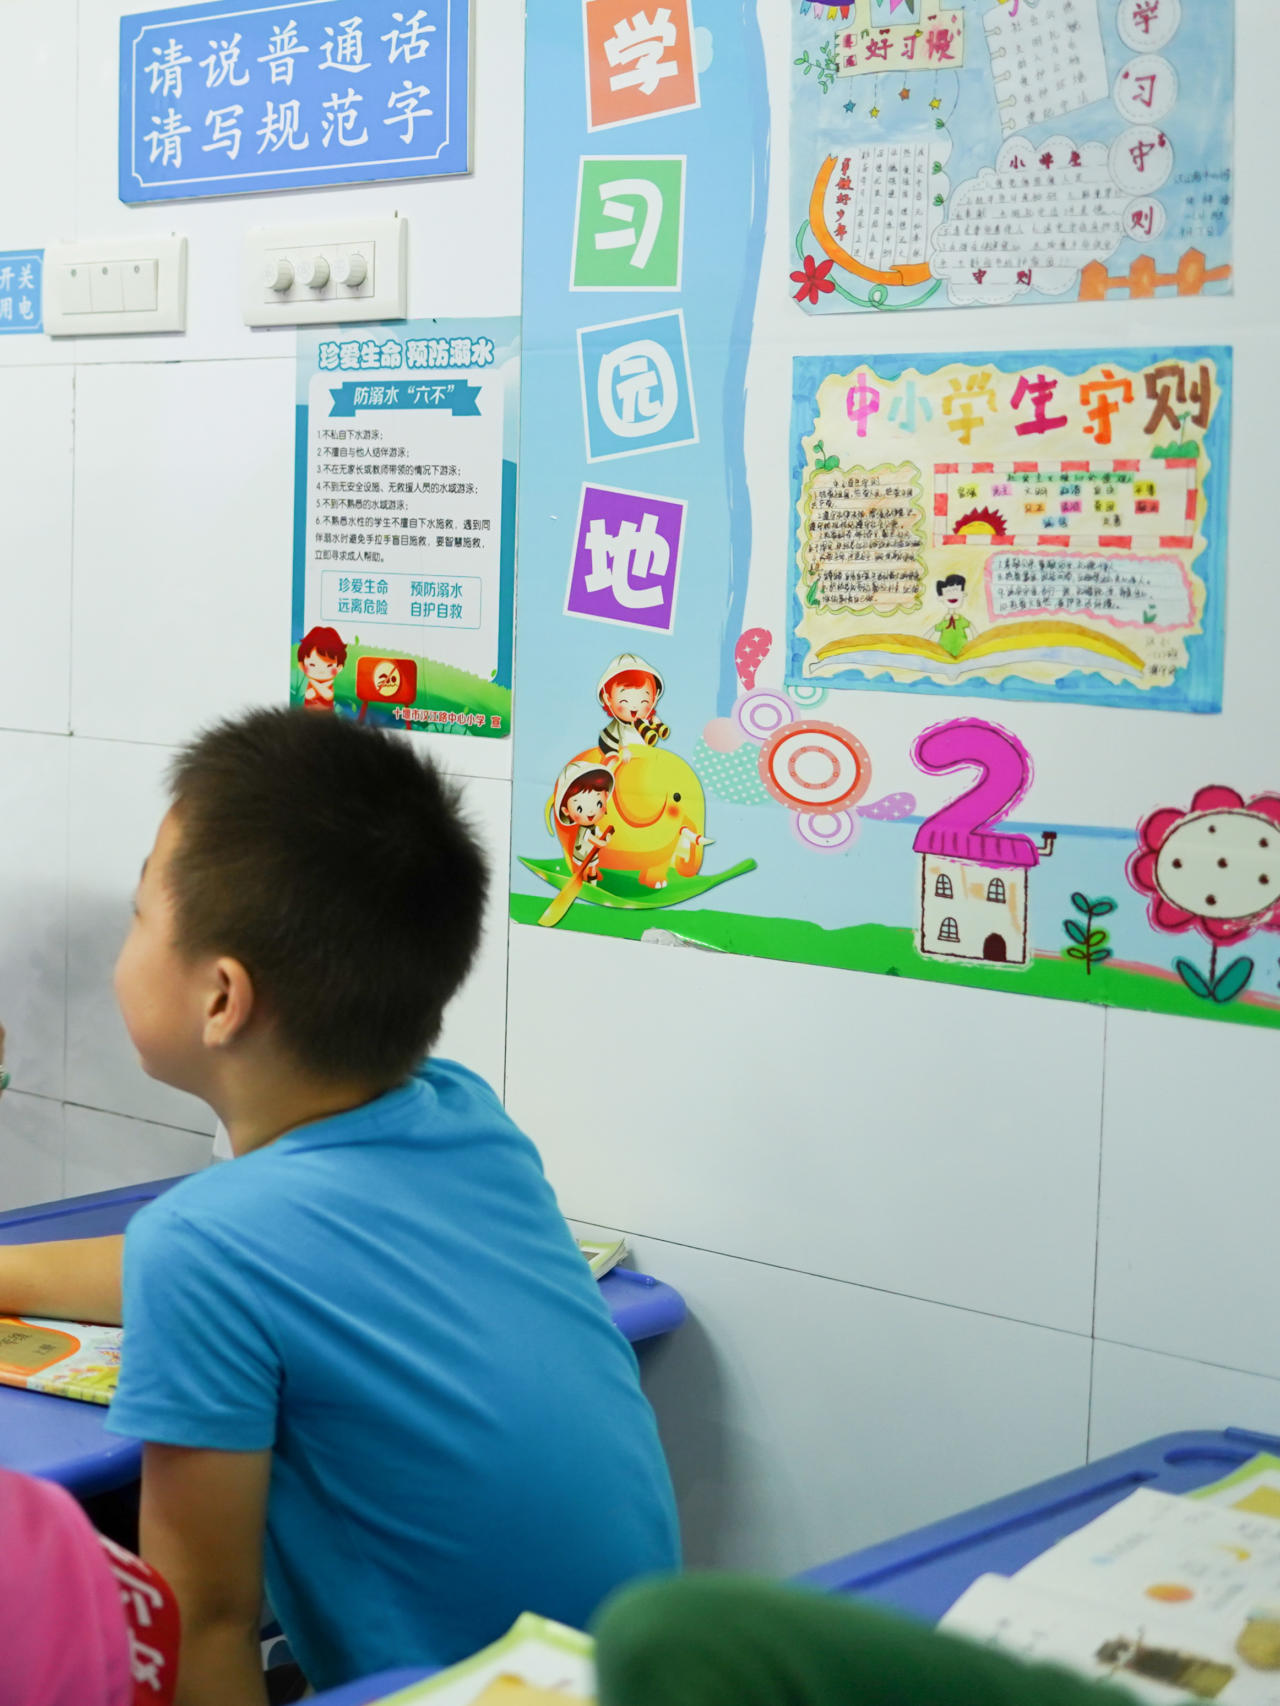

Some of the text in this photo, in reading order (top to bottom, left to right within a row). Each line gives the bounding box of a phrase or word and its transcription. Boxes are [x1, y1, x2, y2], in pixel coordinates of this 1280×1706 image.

[144, 10, 437, 99] 请说普通话
[143, 80, 433, 168] 请写规范字
[585, 7, 679, 609] 学习园地
[319, 337, 494, 370] 珍爱生命 预防溺水
[846, 363, 1212, 445] 中小学生守则
[338, 578, 463, 598] 珍爱生命 预防溺水
[338, 599, 463, 619] 远离危险 自护自救
